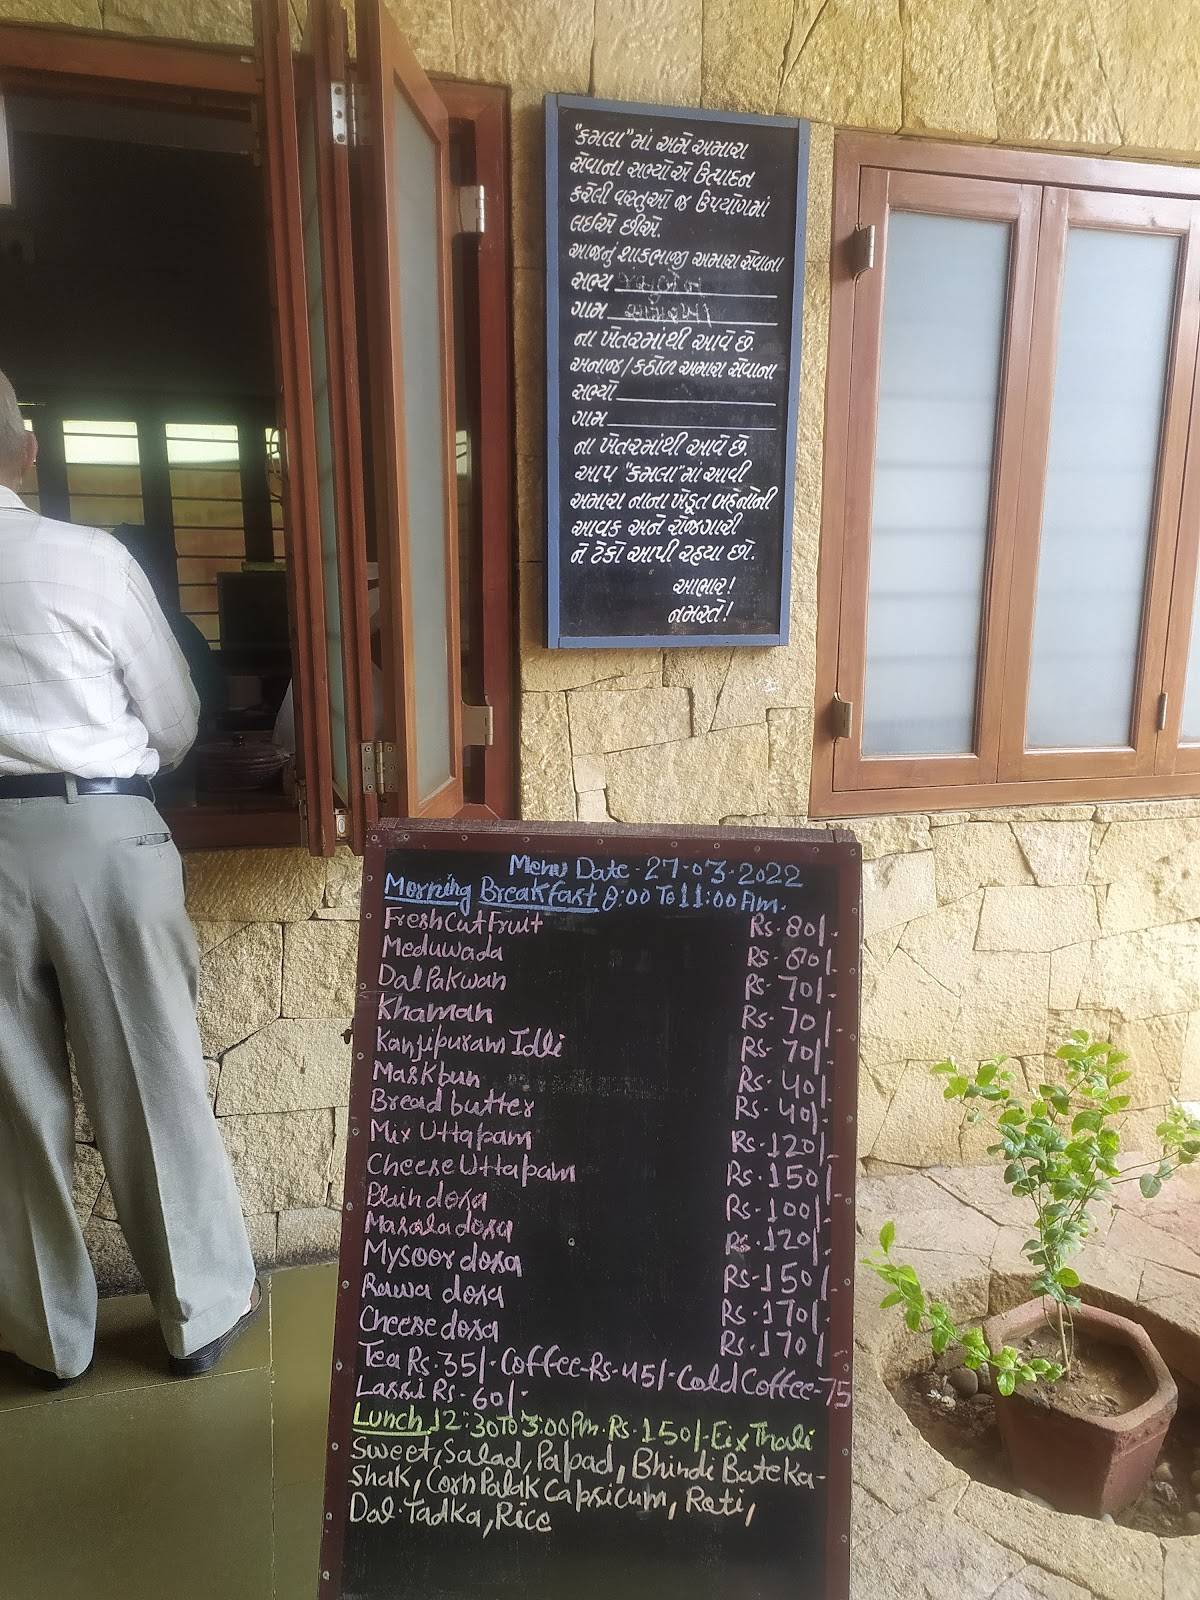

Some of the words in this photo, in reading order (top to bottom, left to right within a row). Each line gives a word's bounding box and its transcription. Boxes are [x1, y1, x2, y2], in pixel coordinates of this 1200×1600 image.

[656, 132, 694, 154] અમે
[692, 140, 750, 160] અમારા
[570, 152, 624, 176] સેવાના
[694, 160, 756, 188] ઉત્પાદન
[570, 181, 614, 205] કરેલી
[674, 195, 692, 212] જ
[696, 190, 771, 217] ઉપયોગમાં
[568, 241, 619, 268] આજનું
[617, 247, 690, 270] શાકભાજી
[692, 251, 740, 270] અમારા
[740, 250, 784, 272] સેવાના
[571, 271, 614, 291] સભ્ય
[571, 300, 608, 320] ગામ
[574, 330, 598, 347] ના
[600, 325, 692, 350] ખેતરમાંથી
[692, 330, 736, 351] આવે
[679, 361, 727, 378] અમારા
[728, 358, 778, 380] સેવાના
[572, 379, 619, 401] સભ્યો
[572, 410, 608, 427] ગામ
[574, 438, 597, 455] ના
[600, 432, 689, 456] ખેતરમાંથી
[686, 434, 730, 456] આવે
[575, 465, 618, 482] આપ
[703, 460, 752, 483] આવી
[570, 493, 625, 510] અમારા
[628, 493, 669, 509] નાના
[671, 488, 712, 514] ખેડૂત
[571, 520, 622, 537] આવક
[628, 514, 666, 535] અને
[668, 512, 743, 536] રોજગારી
[570, 543, 589, 563] ને
[591, 540, 627, 564] ટેકો
[627, 539, 680, 563] આપી
[509, 854, 568, 876] Menu
[384, 873, 472, 916] Morning
[377, 993, 493, 1023] Khaman
[371, 1086, 443, 1113] Bread
[370, 1119, 411, 1144] Mix
[358, 1340, 401, 1369] Tea
